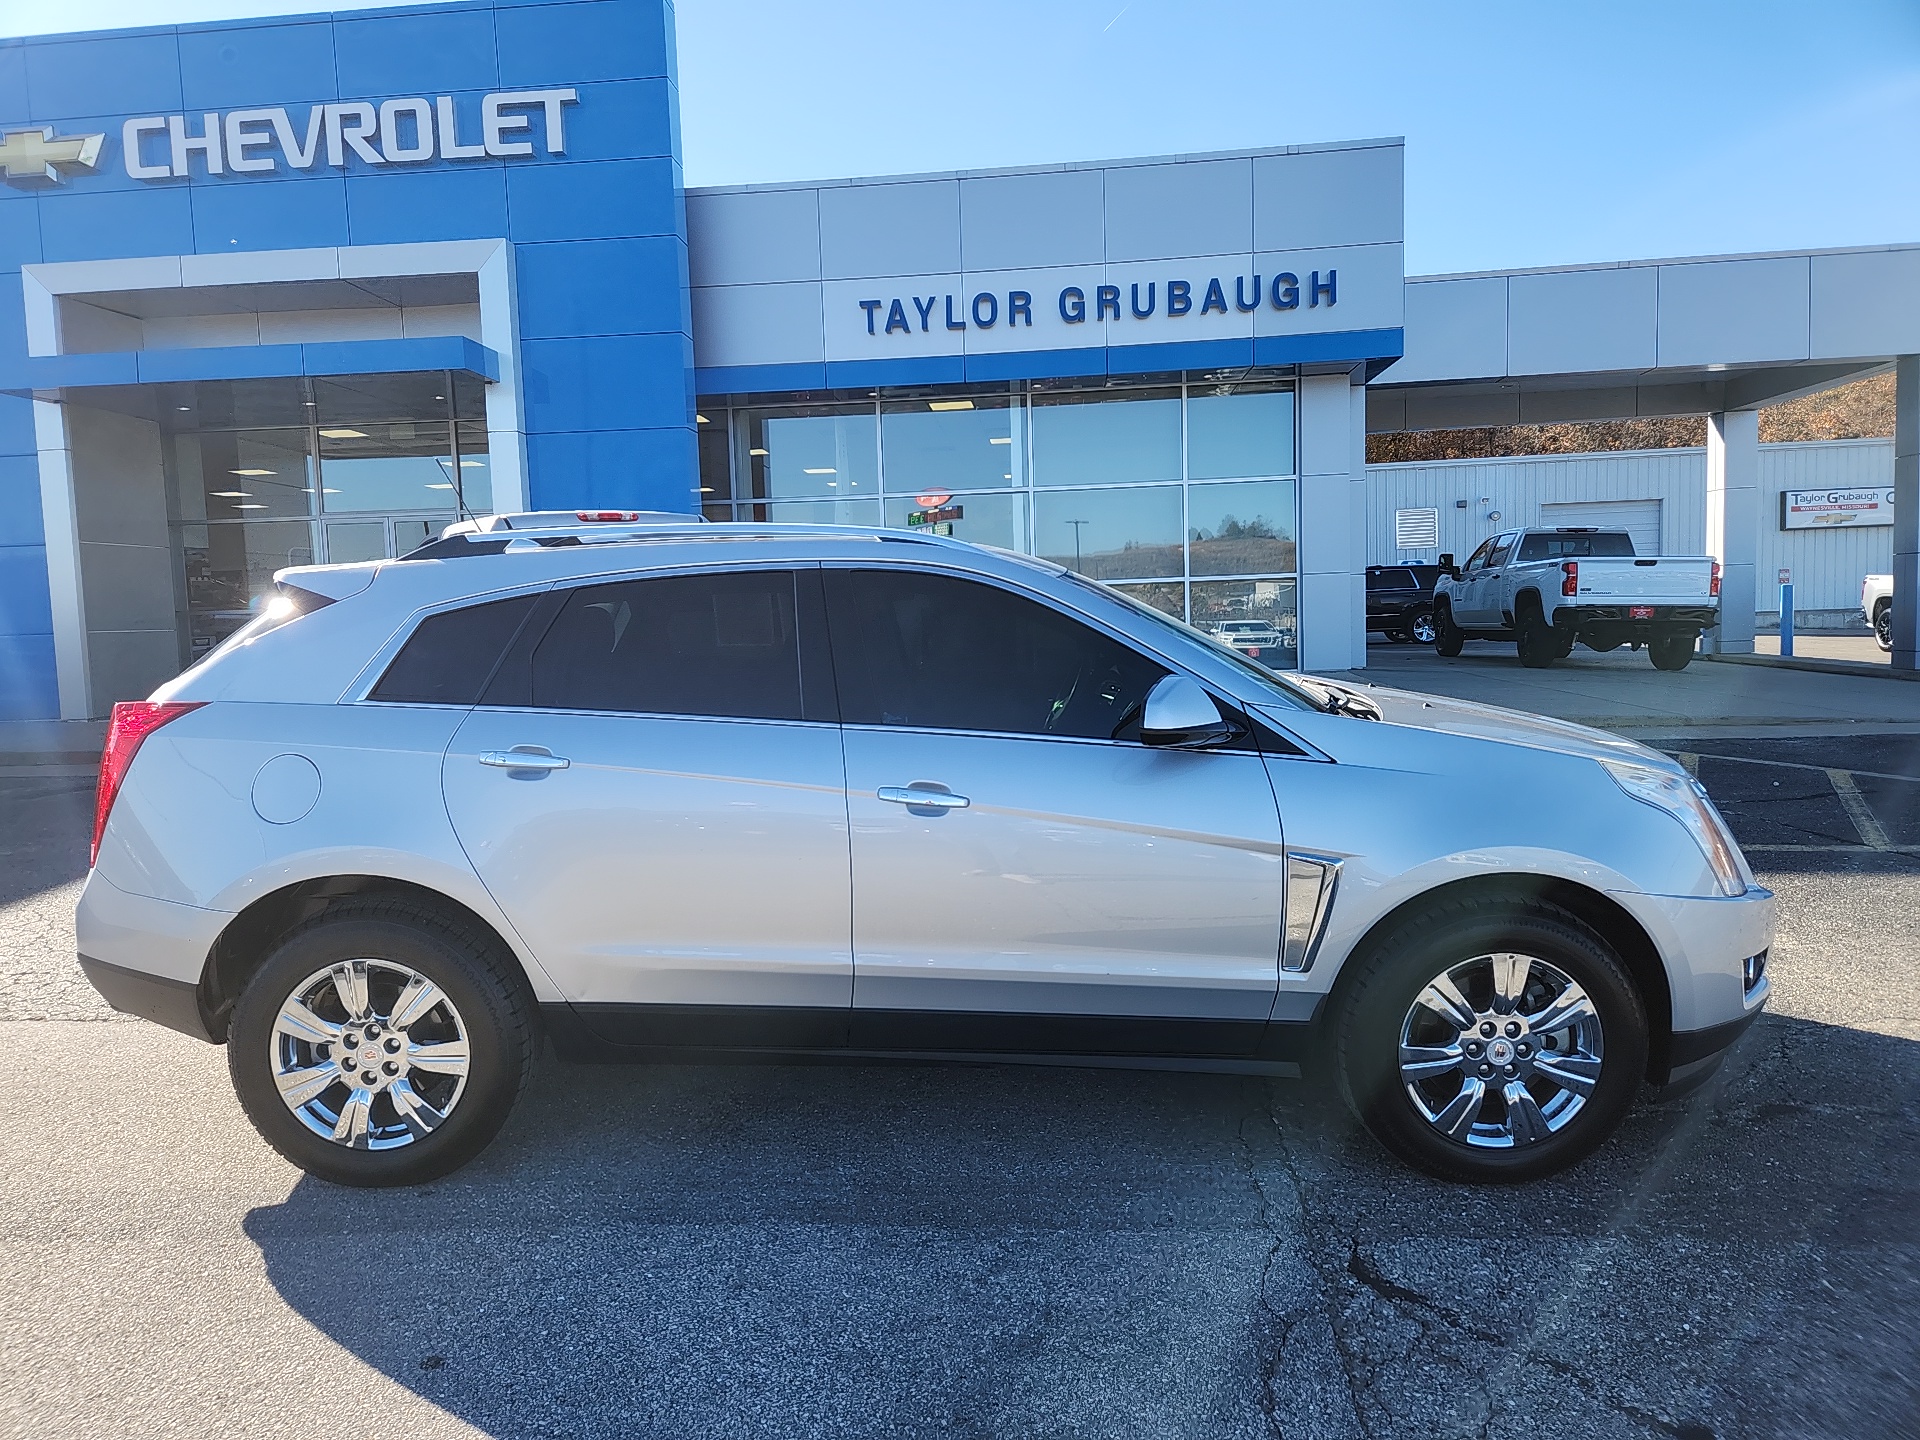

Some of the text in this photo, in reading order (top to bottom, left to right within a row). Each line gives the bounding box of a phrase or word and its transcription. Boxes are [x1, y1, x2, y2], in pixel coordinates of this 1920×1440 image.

[122, 88, 580, 181] CHEVROLET
[859, 269, 1339, 336] TAYLOR GRUBAUGH
[1791, 493, 1826, 506] Taylor
[1827, 492, 1879, 504] Grubaugh
